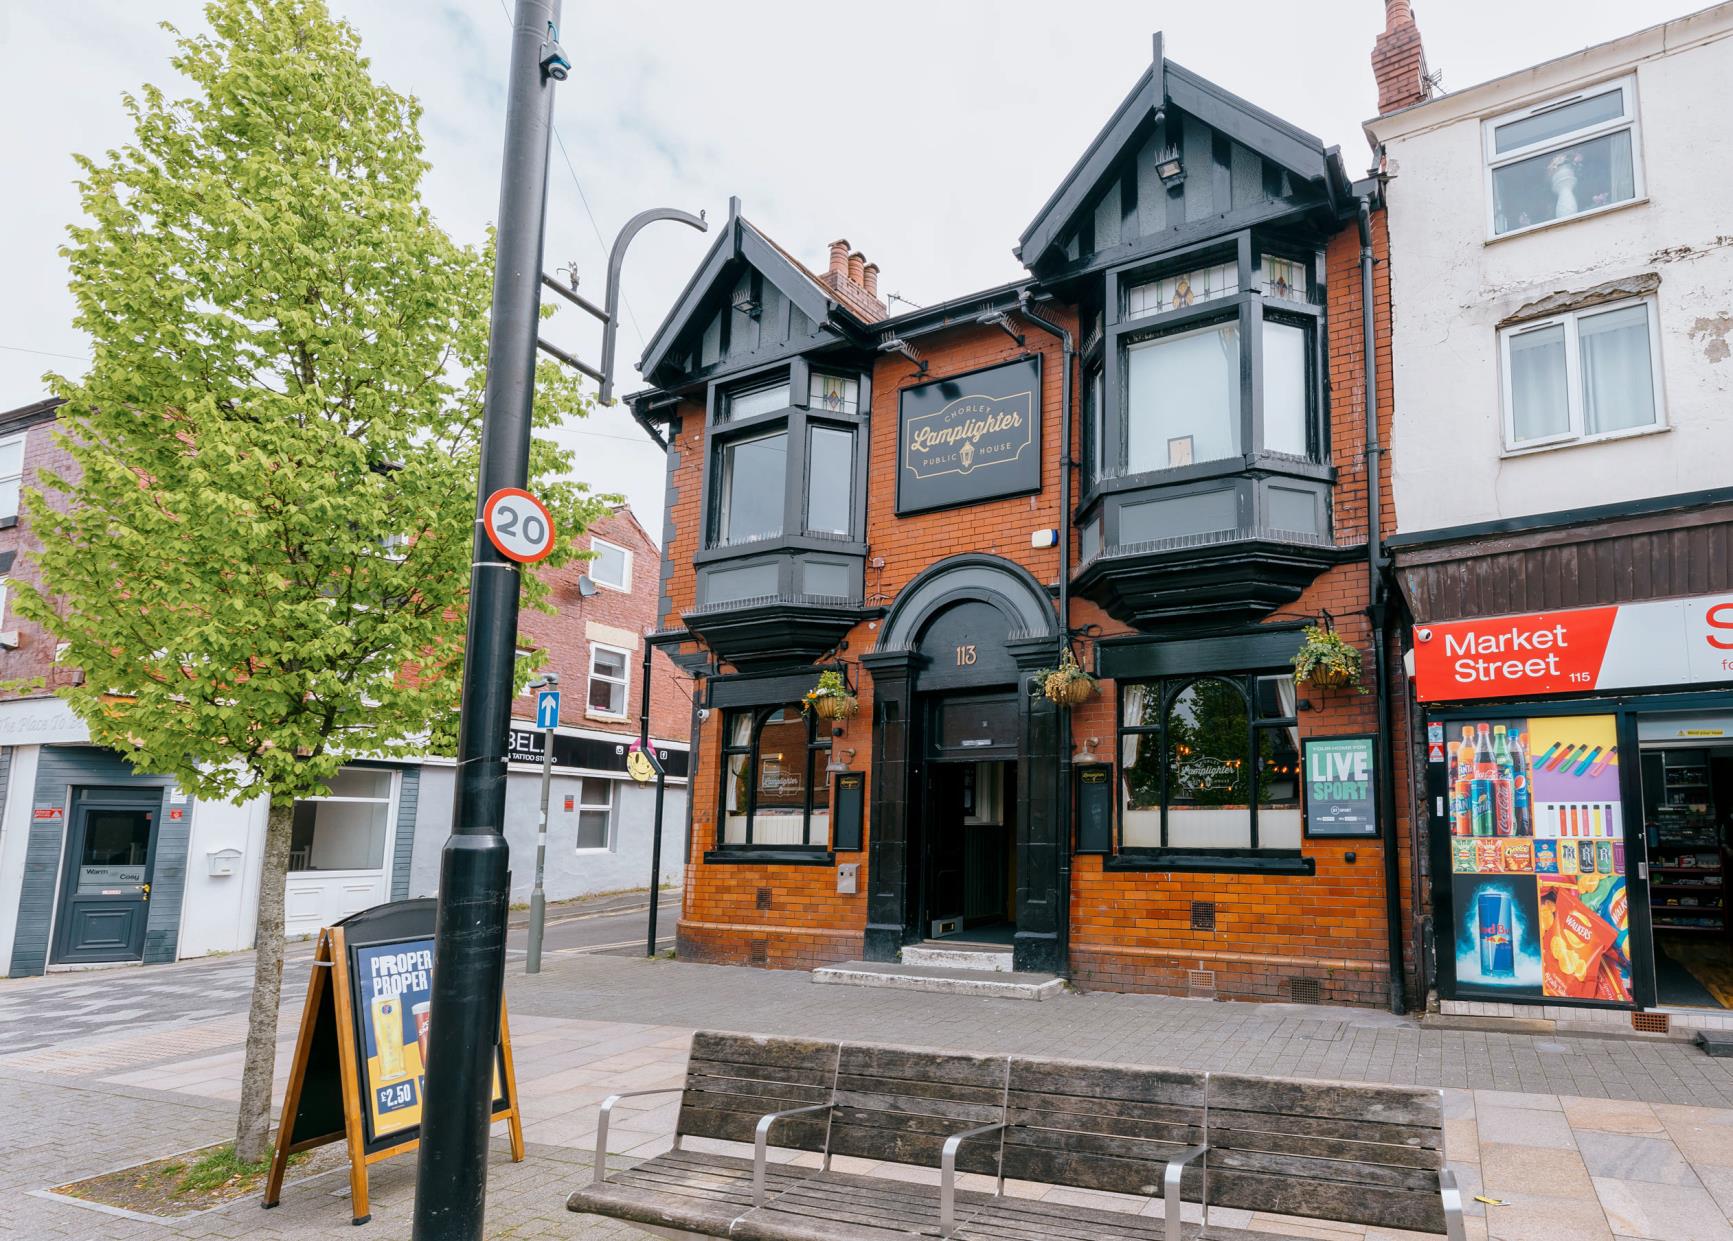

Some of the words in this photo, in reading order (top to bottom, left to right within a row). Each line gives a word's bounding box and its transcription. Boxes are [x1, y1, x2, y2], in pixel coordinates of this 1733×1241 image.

[944, 405, 992, 423] CHORLEY
[911, 411, 1022, 452] Lamplighter
[923, 453, 957, 467] PUBLIC
[979, 442, 1012, 455] HOUSE
[496, 505, 545, 545] 20
[1445, 624, 1568, 657] Market
[956, 644, 977, 666] 113
[1454, 653, 1561, 683] Street
[1568, 672, 1591, 683] 115
[1312, 751, 1368, 782] LIVE
[1313, 781, 1369, 801] SPORT
[1565, 914, 1593, 941] WALKERS
[370, 950, 432, 977] PROPER
[372, 970, 428, 997] PROPER
[381, 1083, 412, 1106] £2.50
